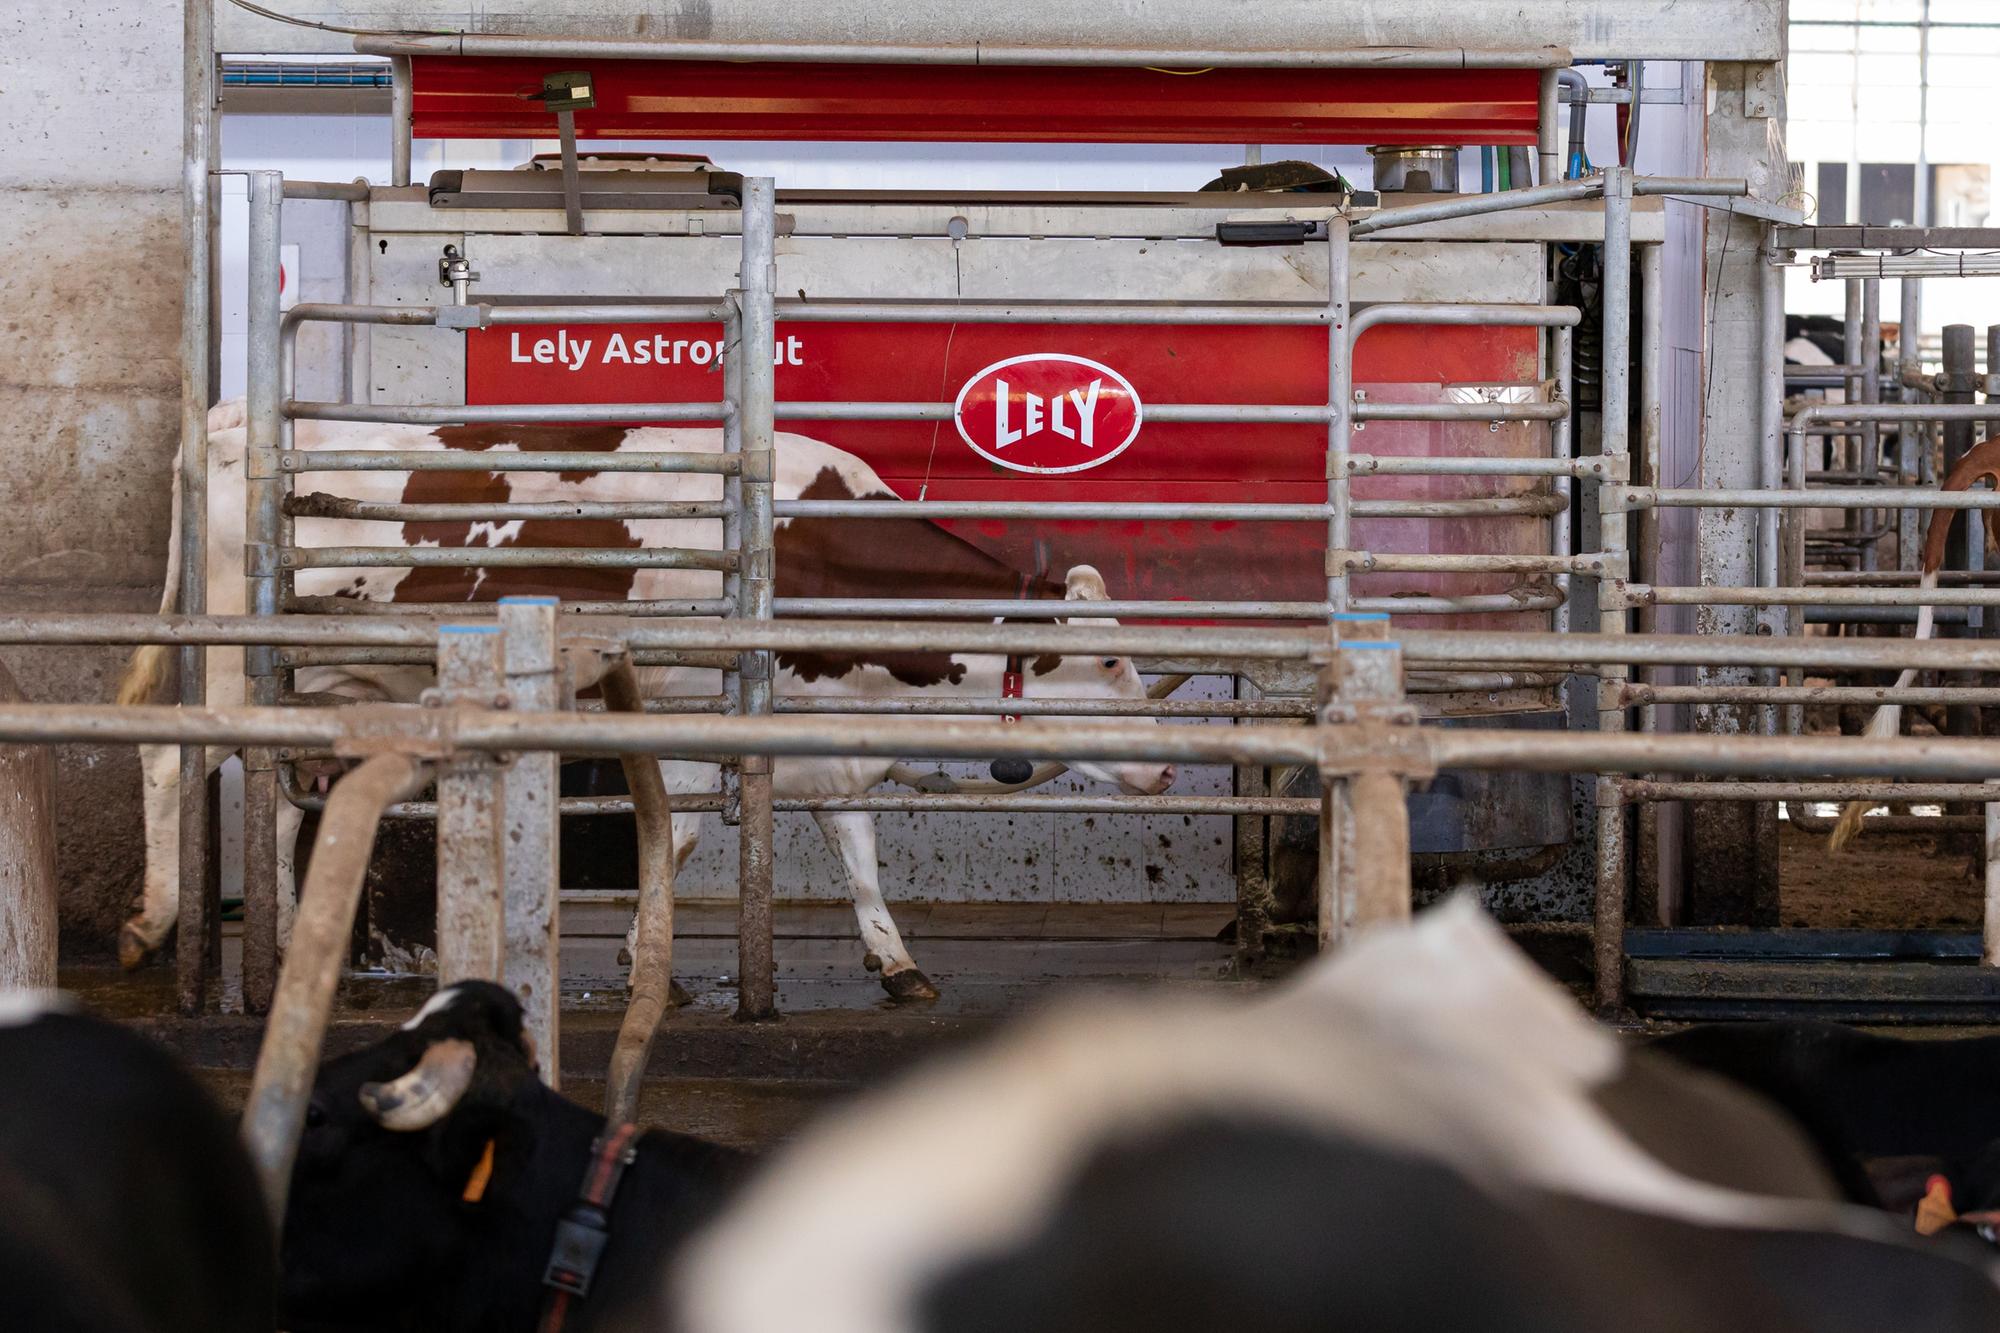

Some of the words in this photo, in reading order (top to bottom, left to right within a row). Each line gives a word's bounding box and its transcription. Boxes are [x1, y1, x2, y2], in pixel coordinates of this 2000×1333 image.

[511, 330, 592, 371] Lely
[602, 333, 803, 367] Astrot
[996, 378, 1102, 449] LELY
